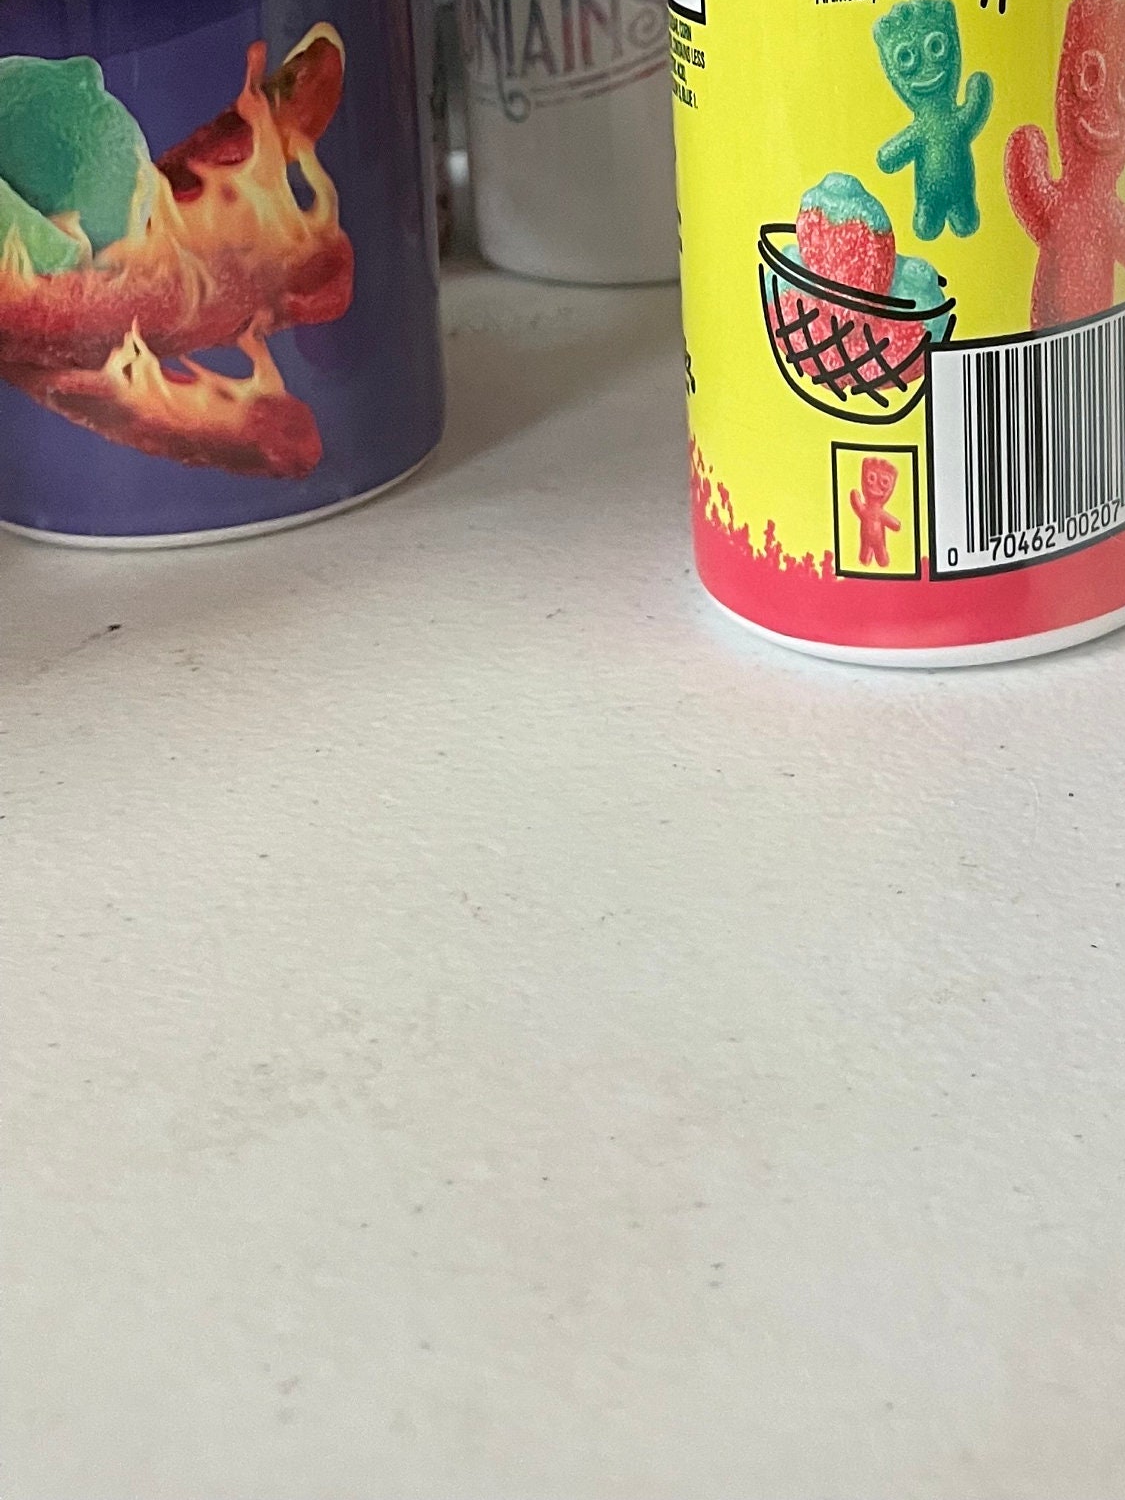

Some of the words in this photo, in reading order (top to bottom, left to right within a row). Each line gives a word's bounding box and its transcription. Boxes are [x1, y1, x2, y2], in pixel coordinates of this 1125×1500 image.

[947, 547, 958, 567] 0
[988, 524, 1056, 562] 70462
[1065, 499, 1121, 541] 00207
